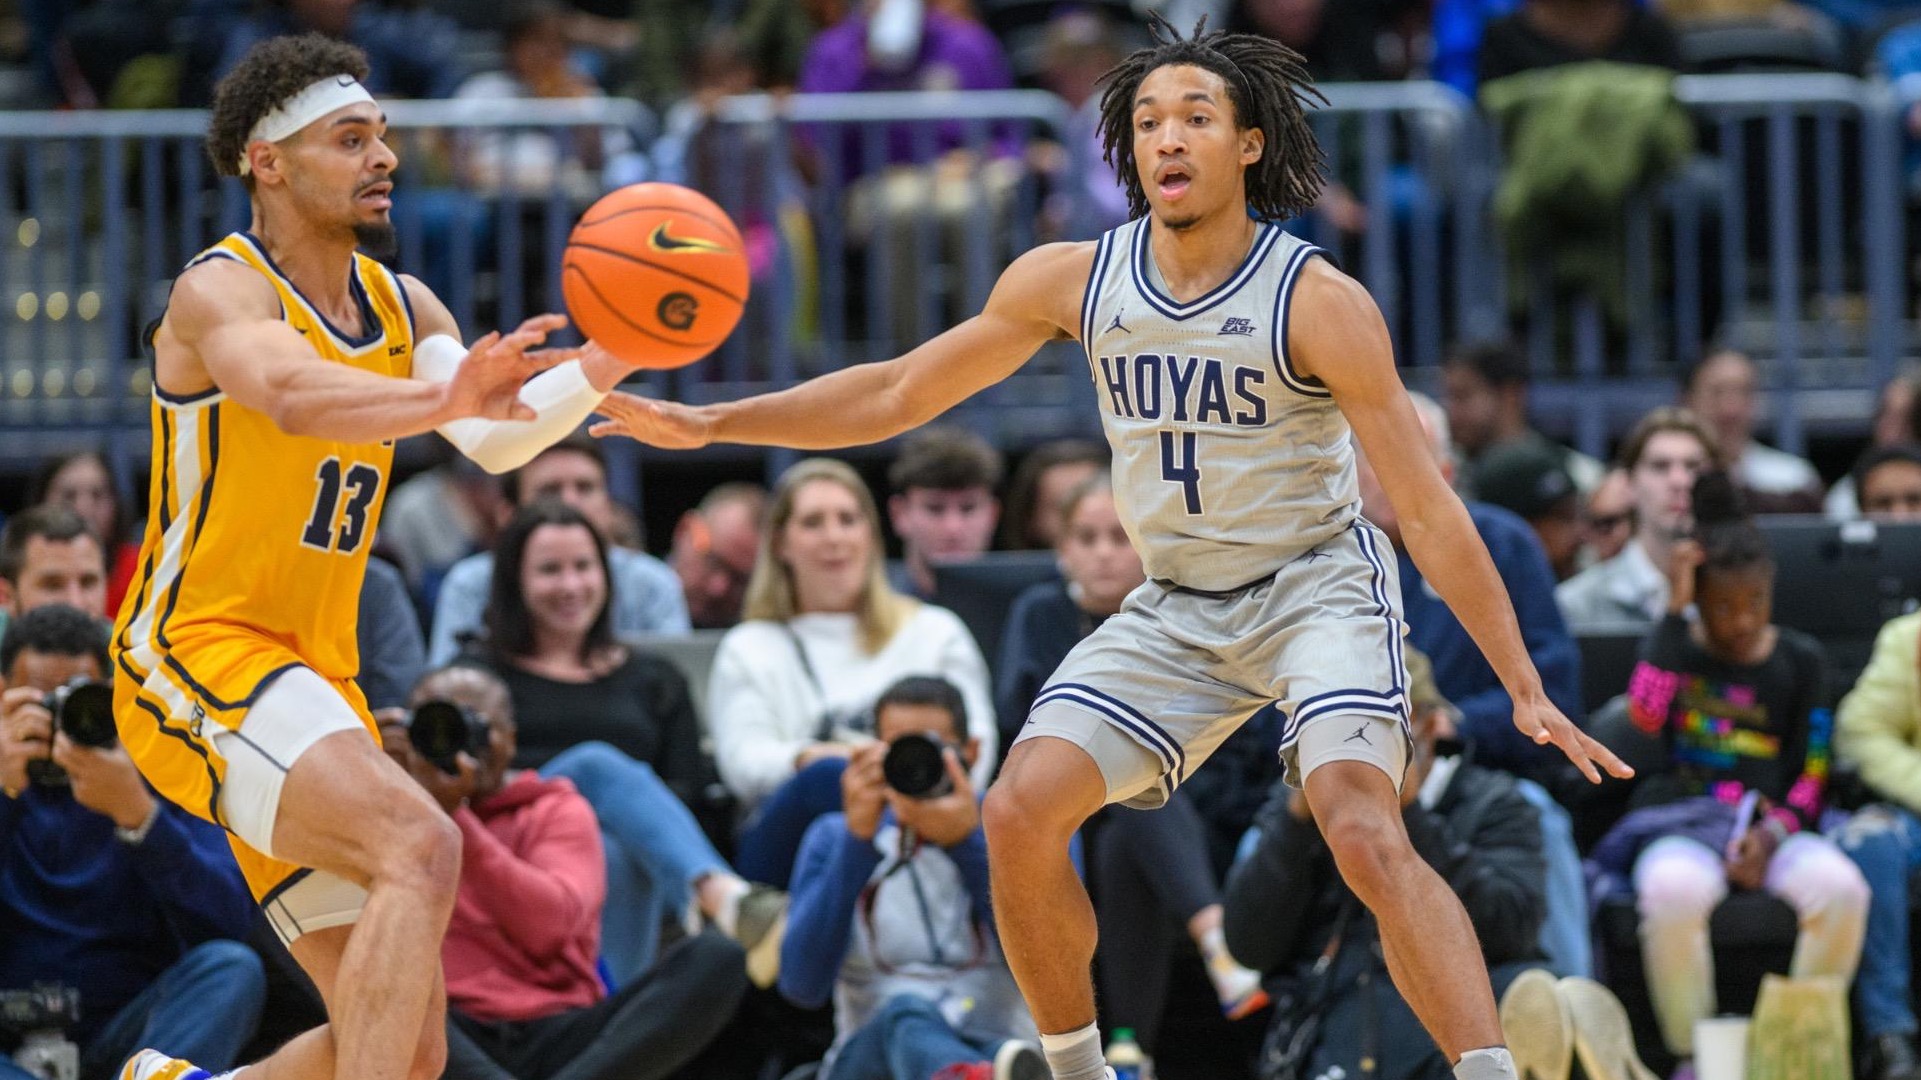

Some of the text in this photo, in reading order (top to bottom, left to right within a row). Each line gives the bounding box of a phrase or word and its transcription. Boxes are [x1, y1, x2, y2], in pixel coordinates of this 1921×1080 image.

[1220, 325, 1257, 333] EAST
[1225, 317, 1251, 326] BIG
[1099, 353, 1268, 427] HOYAS
[299, 454, 382, 557] 13
[1158, 429, 1204, 516] 4
